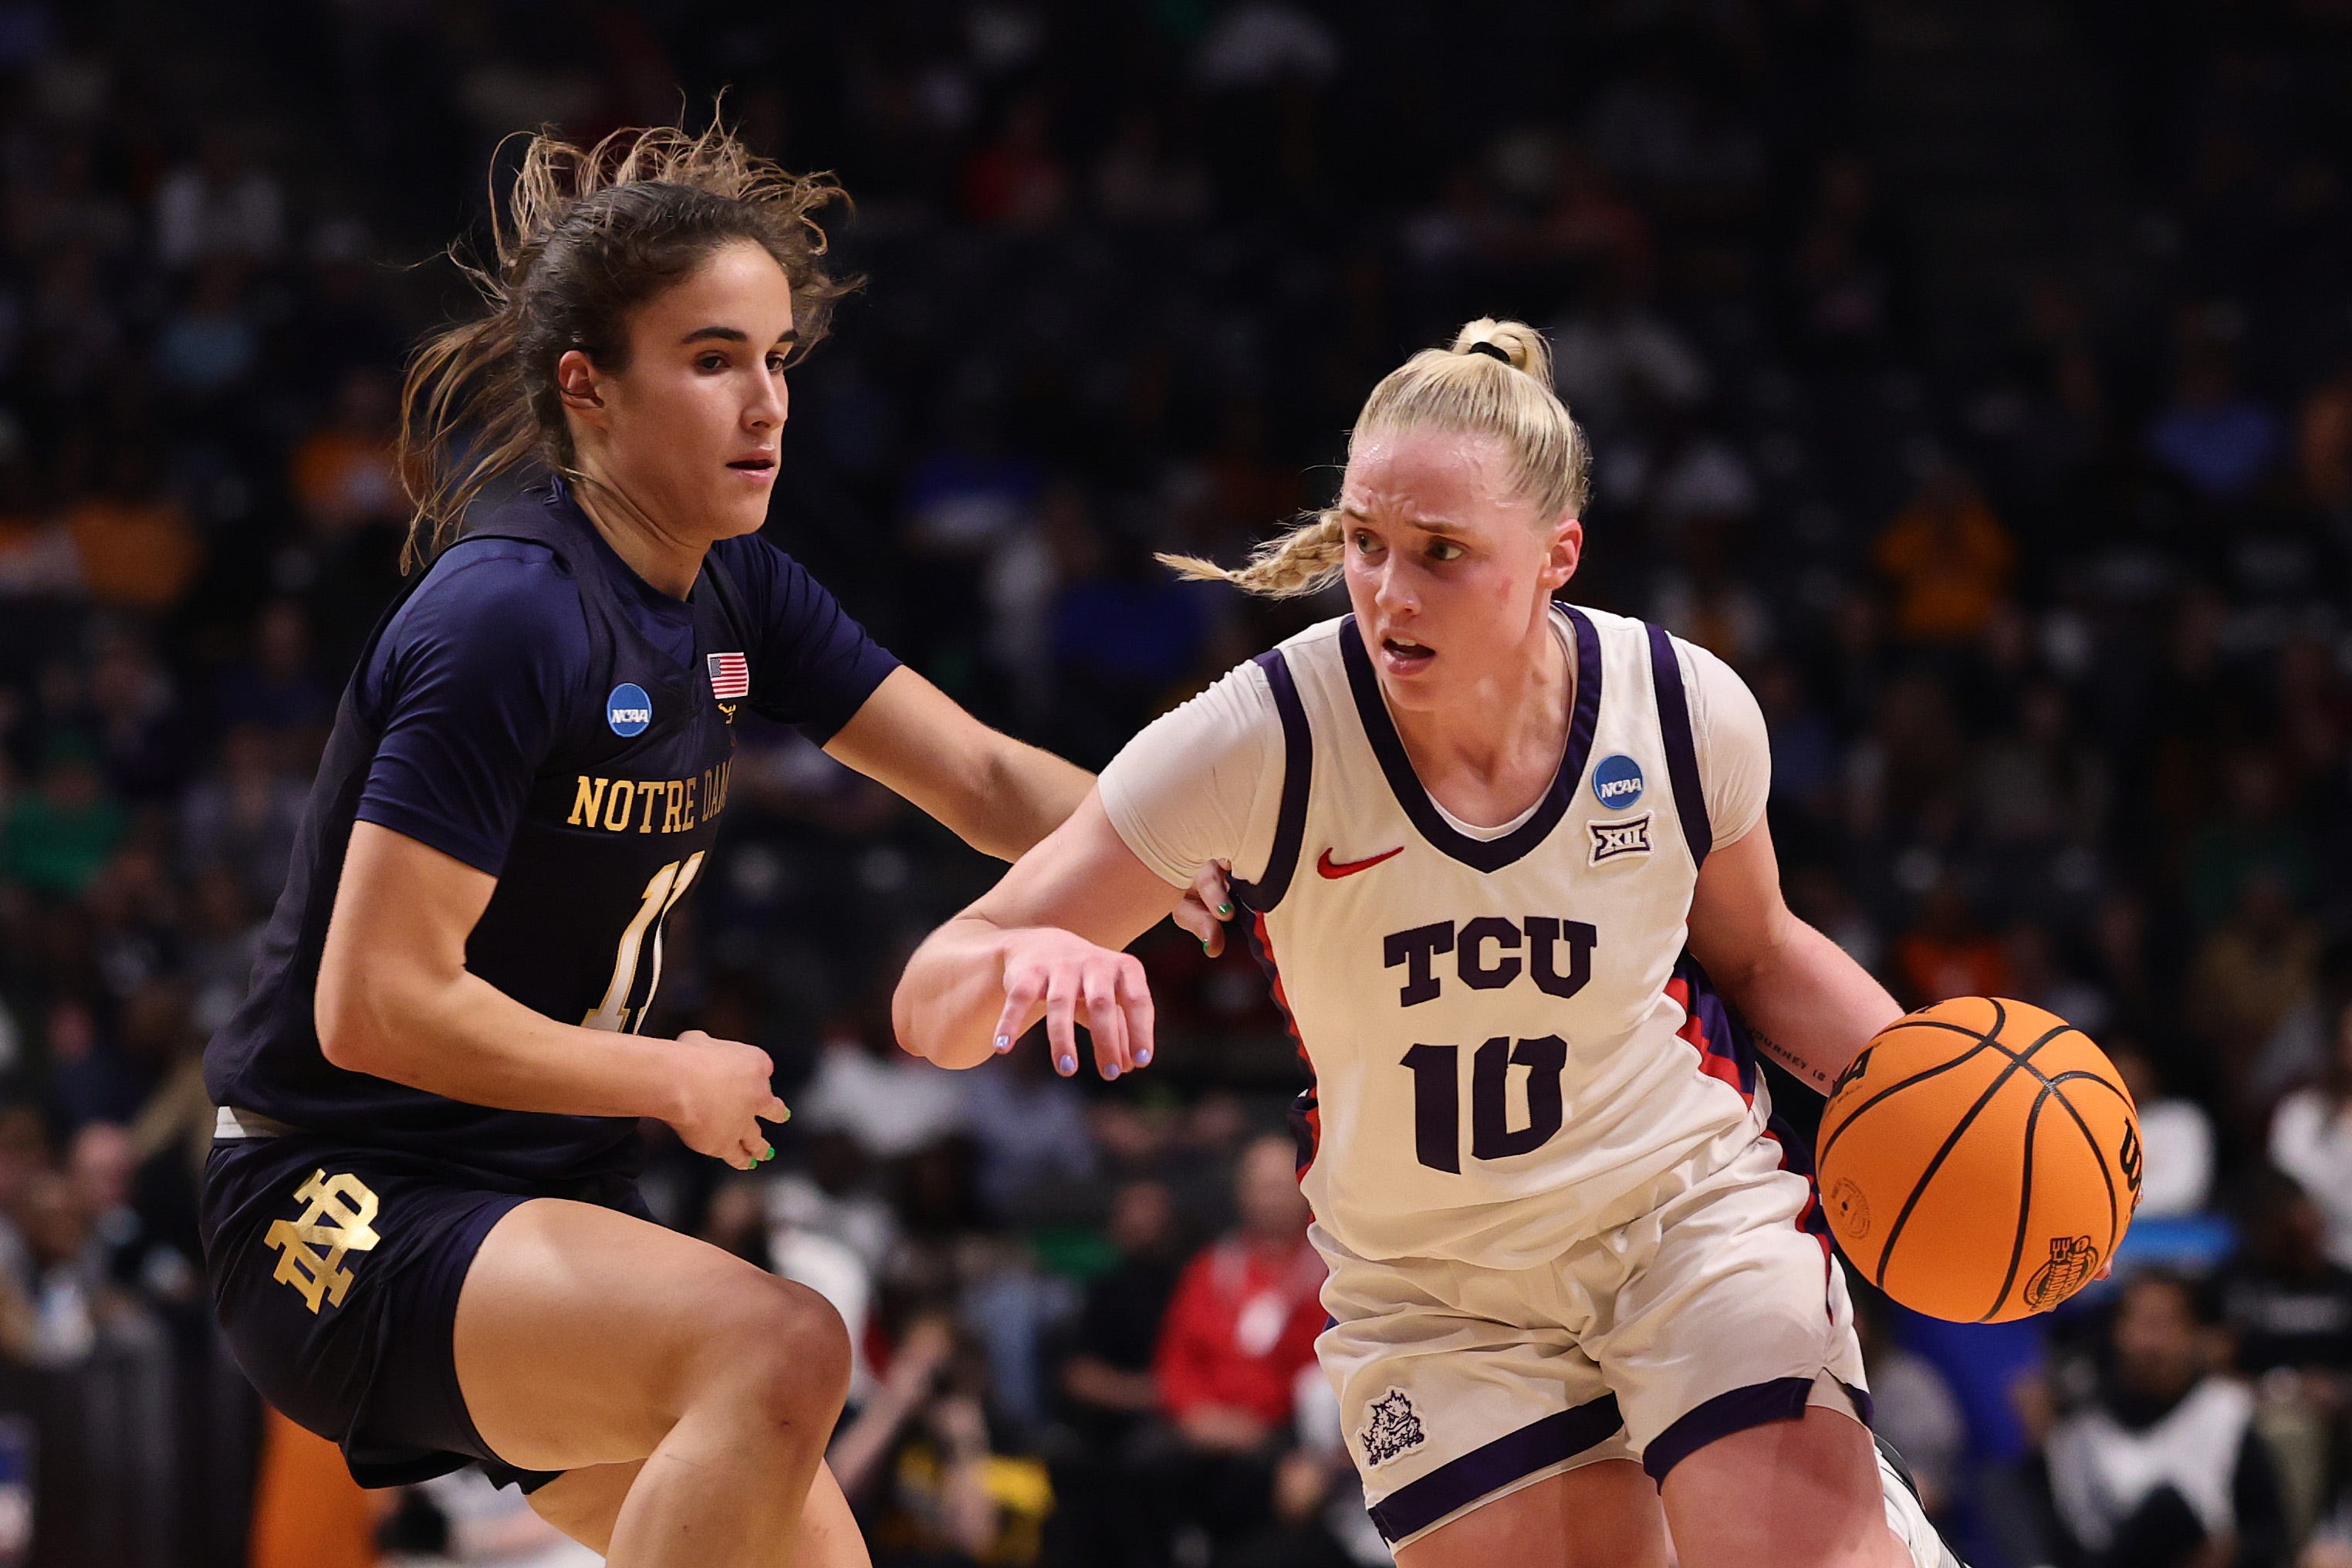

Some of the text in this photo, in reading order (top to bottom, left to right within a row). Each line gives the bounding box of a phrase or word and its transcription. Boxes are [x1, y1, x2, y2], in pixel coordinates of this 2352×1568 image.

[612, 709, 649, 723] NCAA
[567, 755, 735, 833] NOTRE DAM
[1600, 778, 1642, 799] NCAA
[1596, 822, 1647, 857] XII
[580, 850, 705, 1036] 11
[1384, 916, 1597, 1008] TCU
[1399, 1034, 1568, 1175] 10
